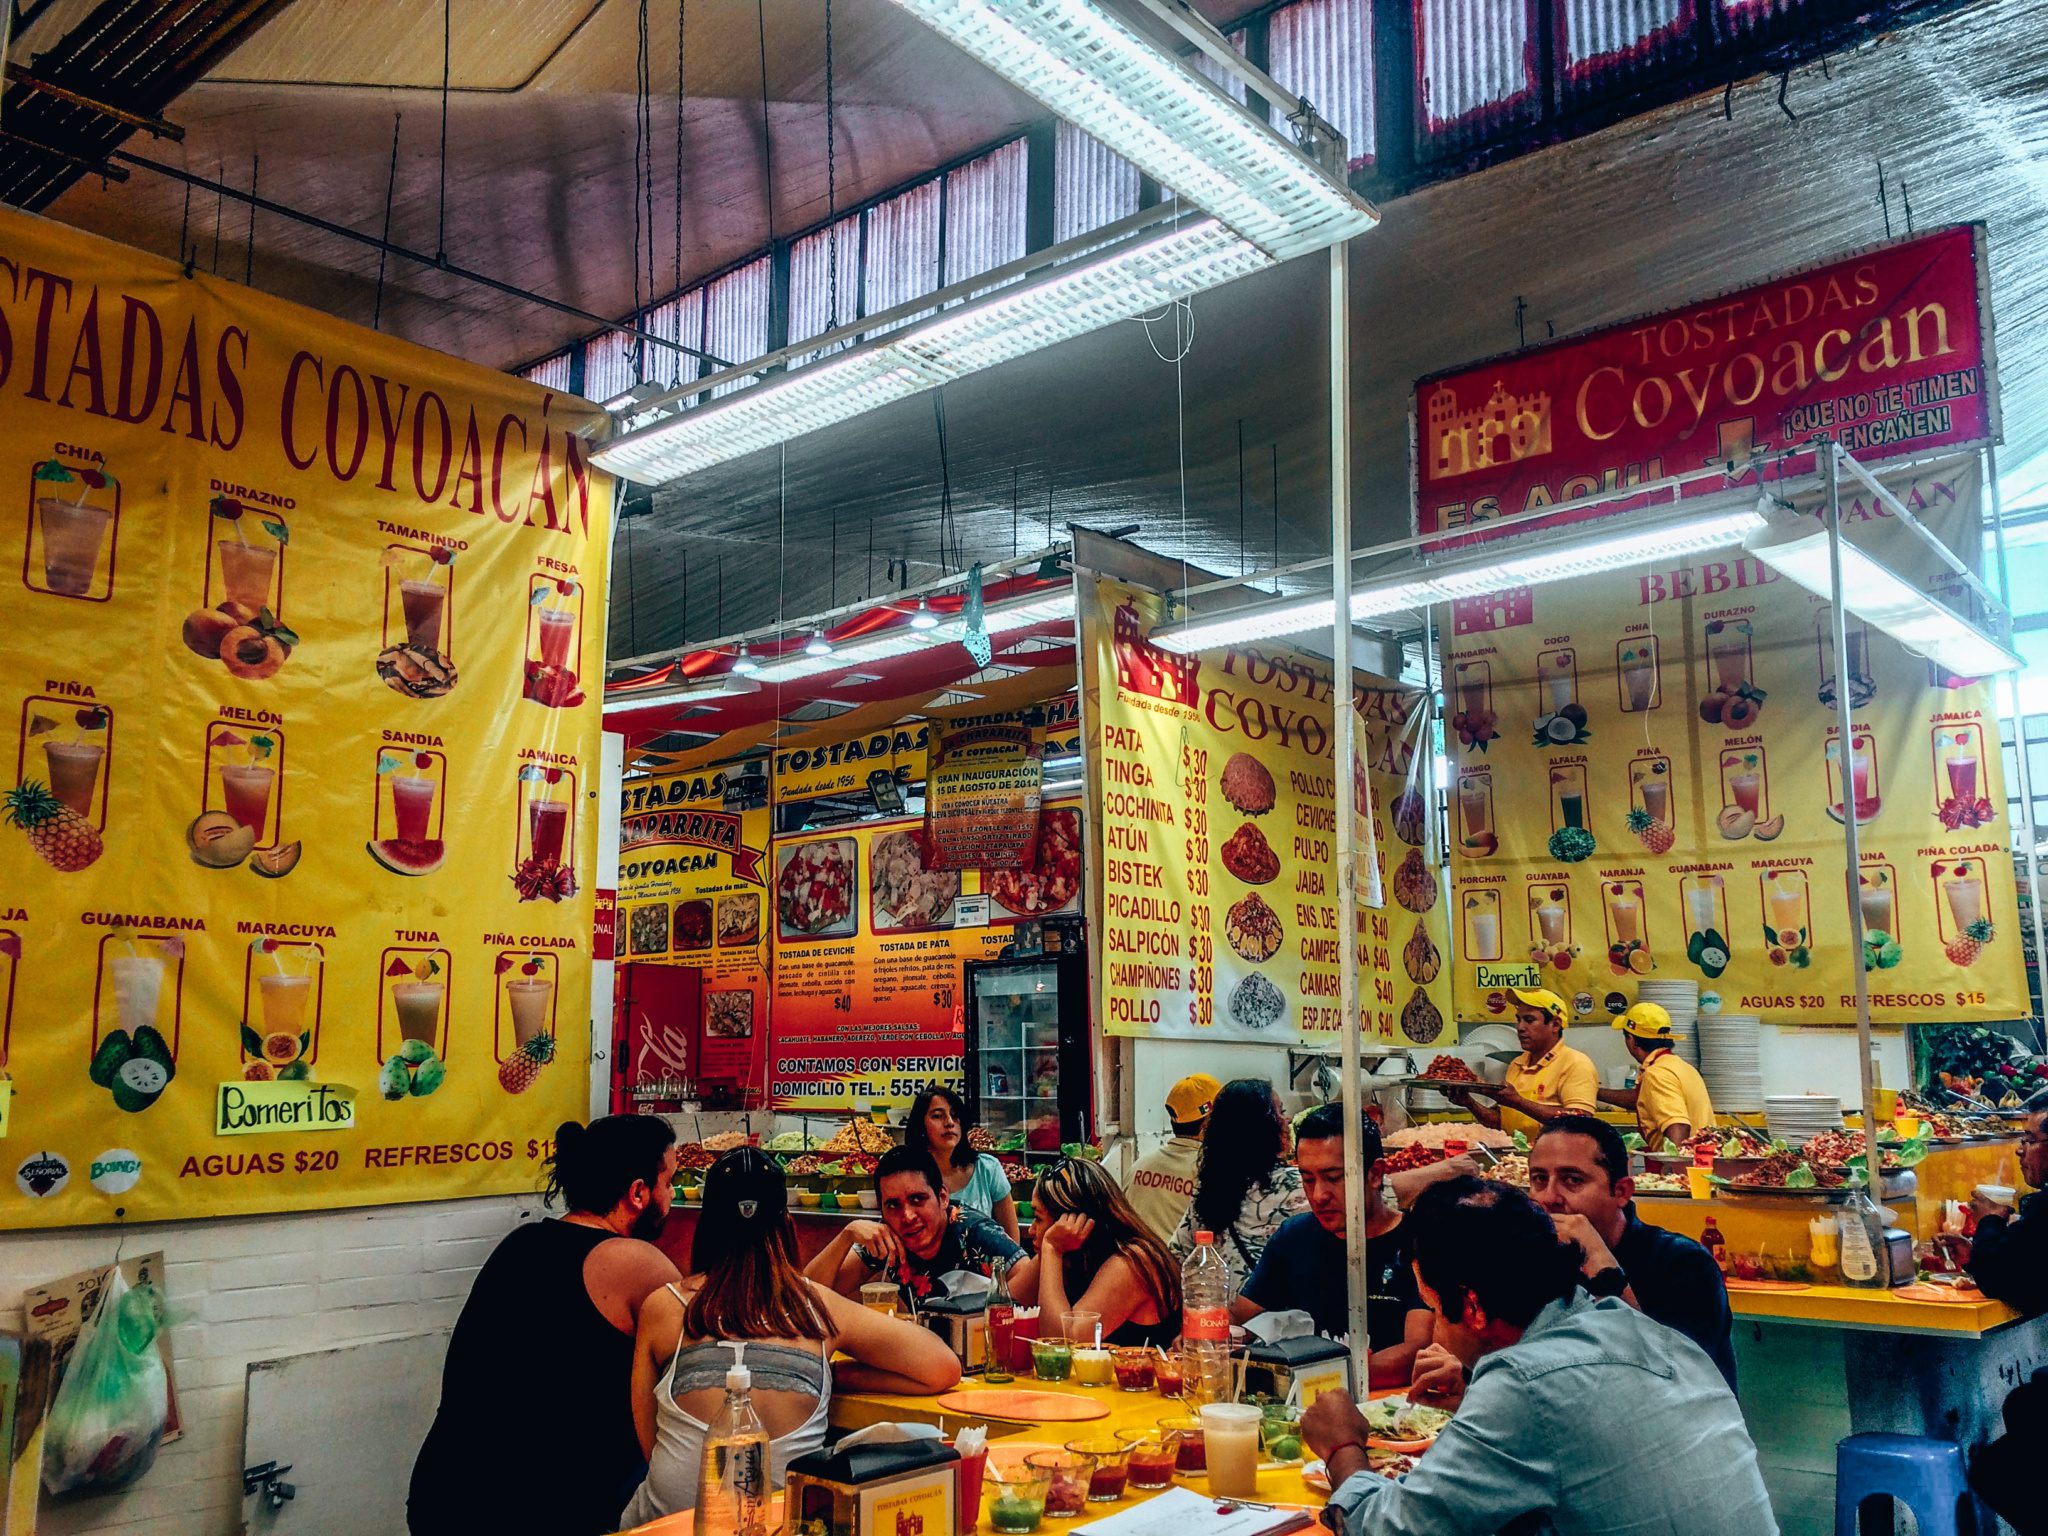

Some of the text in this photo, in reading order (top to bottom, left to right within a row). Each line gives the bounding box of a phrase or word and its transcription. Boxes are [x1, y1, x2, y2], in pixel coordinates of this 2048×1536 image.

[1632, 264, 1879, 367] TOSTADAS
[1576, 301, 1957, 440] Coyoacan
[1783, 368, 1978, 440] ¡QUE NO TE TIMEN
[1839, 406, 1952, 451] ENGAÑEN!
[54, 442, 104, 463] CHIA
[280, 350, 597, 541] COYOACÁN
[210, 479, 297, 510] DURAZNO
[377, 520, 469, 551] TAMARINDO
[537, 555, 579, 576] FRESA
[1704, 605, 1756, 620] DURAZNO
[1625, 622, 1650, 633] CHIA
[1543, 635, 1570, 646] COCO
[45, 679, 96, 699] PIÑA
[219, 705, 283, 725] MELÓN
[1154, 703, 1180, 718] desde
[1928, 709, 1983, 723] JAMAICA
[382, 729, 444, 747] SANDIA
[1105, 724, 1145, 754] PATA
[1826, 723, 1871, 736] SADIA
[1724, 734, 1763, 747] MELÓN
[517, 748, 578, 766] JAMAICA
[775, 726, 929, 776] TOSTADAS
[1549, 754, 1588, 766] ALFALFA
[938, 766, 1038, 784] GRAN INAUGURACIÓN
[1105, 758, 1155, 789] TINGA
[1460, 763, 1491, 774] MANGO
[781, 775, 855, 799] Fundada desde 1956
[937, 779, 1039, 795] 15 DE AGOSTO DE 2014
[1290, 771, 1325, 798] POLLO
[1296, 803, 1336, 833] CEVICHE
[1108, 822, 1148, 853] ATÚN
[1294, 836, 1329, 864] PULPO
[1856, 851, 1885, 862] UNA
[1917, 843, 2000, 858] PIÑA COLADA
[1668, 862, 1735, 875] GUANABANA
[1750, 857, 1814, 869] MARACUYA
[1108, 859, 1163, 889] BISTEK
[1459, 875, 1507, 885] HORCHATA
[1525, 872, 1571, 882] GUAYABA
[1600, 868, 1645, 879] NARANJA
[1296, 870, 1325, 897] JAIBA
[1108, 893, 1181, 924] PICADILLO
[81, 912, 206, 931] GUANABANA
[237, 922, 337, 938] MARACUYA
[1296, 904, 1321, 929] ENS.
[1322, 907, 1337, 930] DE
[1371, 914, 1389, 941] $40
[395, 930, 440, 942] TUNA
[483, 932, 576, 949] PIÑA COLADA
[880, 939, 950, 952] TOSTADA DE PATA
[1108, 927, 1180, 957] SALPICÓN
[779, 946, 855, 960] TOSTADA DE CEVICHE
[873, 957, 886, 965] Con
[899, 955, 913, 963] base
[914, 954, 922, 962] de
[1373, 946, 1390, 973] $40
[1109, 961, 1181, 991] CHAMPIÑONES
[933, 989, 952, 1009] $30
[1374, 977, 1394, 1005] $40
[1740, 995, 1796, 1009] AGUAS
[1799, 995, 1825, 1009] $20
[1955, 992, 1985, 1006] $15
[1110, 997, 1161, 1024] POLLO
[836, 1025, 849, 1033] CON
[850, 1024, 862, 1032] LAS
[863, 1024, 892, 1032] MEJORES
[1302, 1007, 1319, 1031] ESP.
[1320, 1008, 1332, 1031] DE
[1378, 1011, 1394, 1038] $40
[900, 1033, 914, 1041] CON
[915, 1033, 945, 1041] CEBOLLA
[777, 1057, 856, 1074] CONTAMOS
[859, 1057, 892, 1074] CON
[772, 1081, 846, 1097] DOMICILIO
[179, 1152, 285, 1178] AGUAS
[295, 1150, 339, 1174] $20
[364, 1141, 513, 1169] REFRESCOS
[1133, 1170, 1195, 1197] RODRIGO
